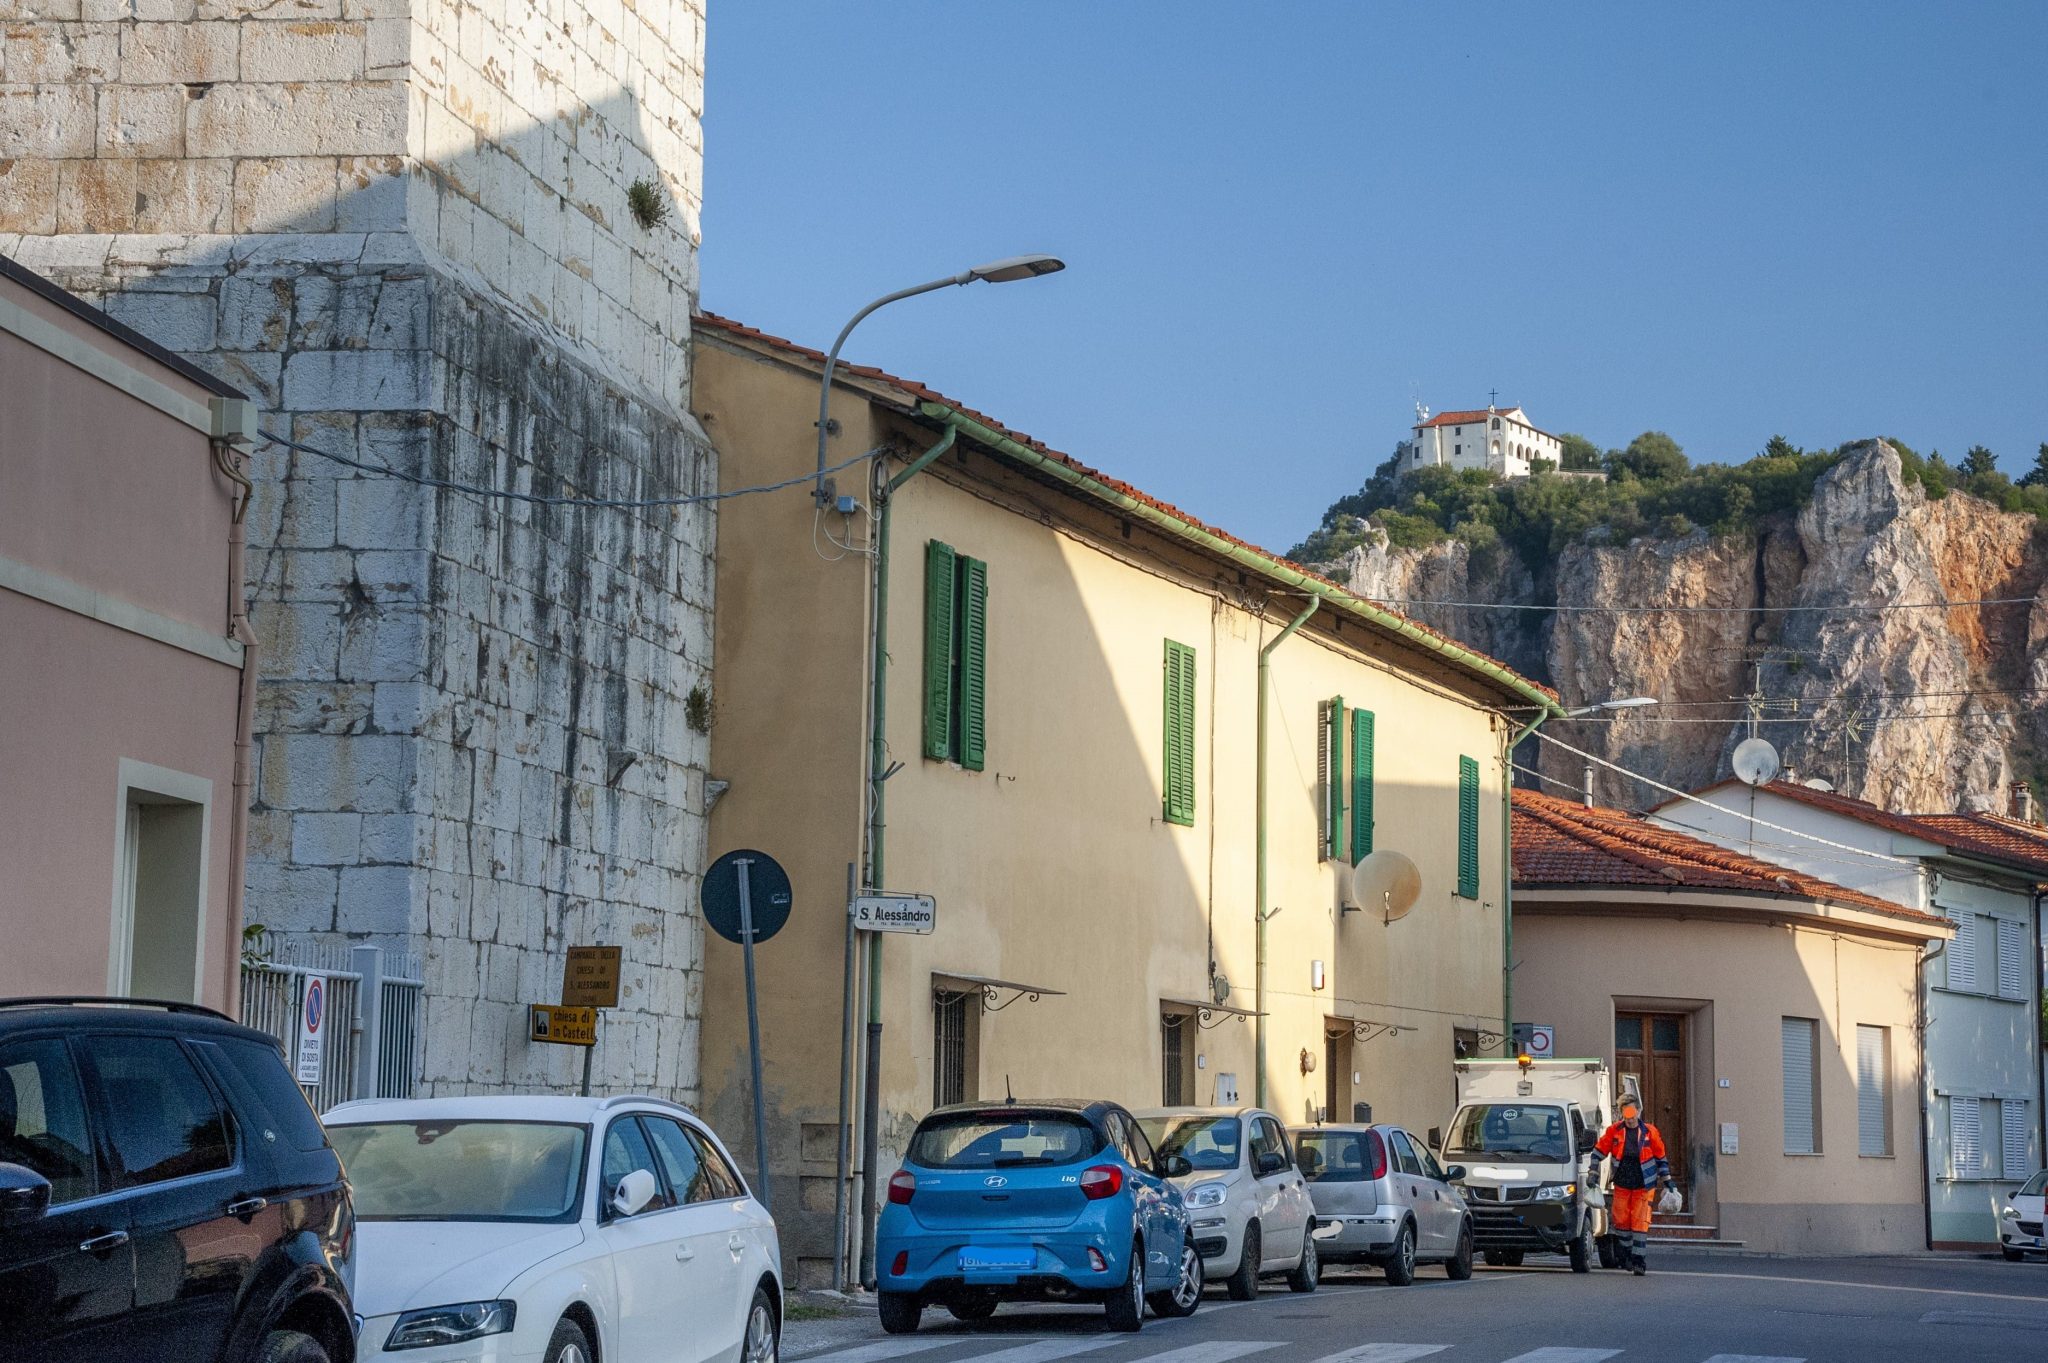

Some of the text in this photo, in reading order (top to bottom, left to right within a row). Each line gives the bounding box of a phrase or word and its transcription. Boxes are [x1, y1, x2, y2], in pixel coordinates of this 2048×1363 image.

[860, 906, 931, 922] S. Alessandro
[577, 980, 610, 990] ALESSANDRO
[553, 1009, 590, 1024] chiesa di
[553, 1025, 561, 1038] in
[304, 1039, 319, 1049] DIVIETO
[307, 1052, 319, 1063] SOSTA
